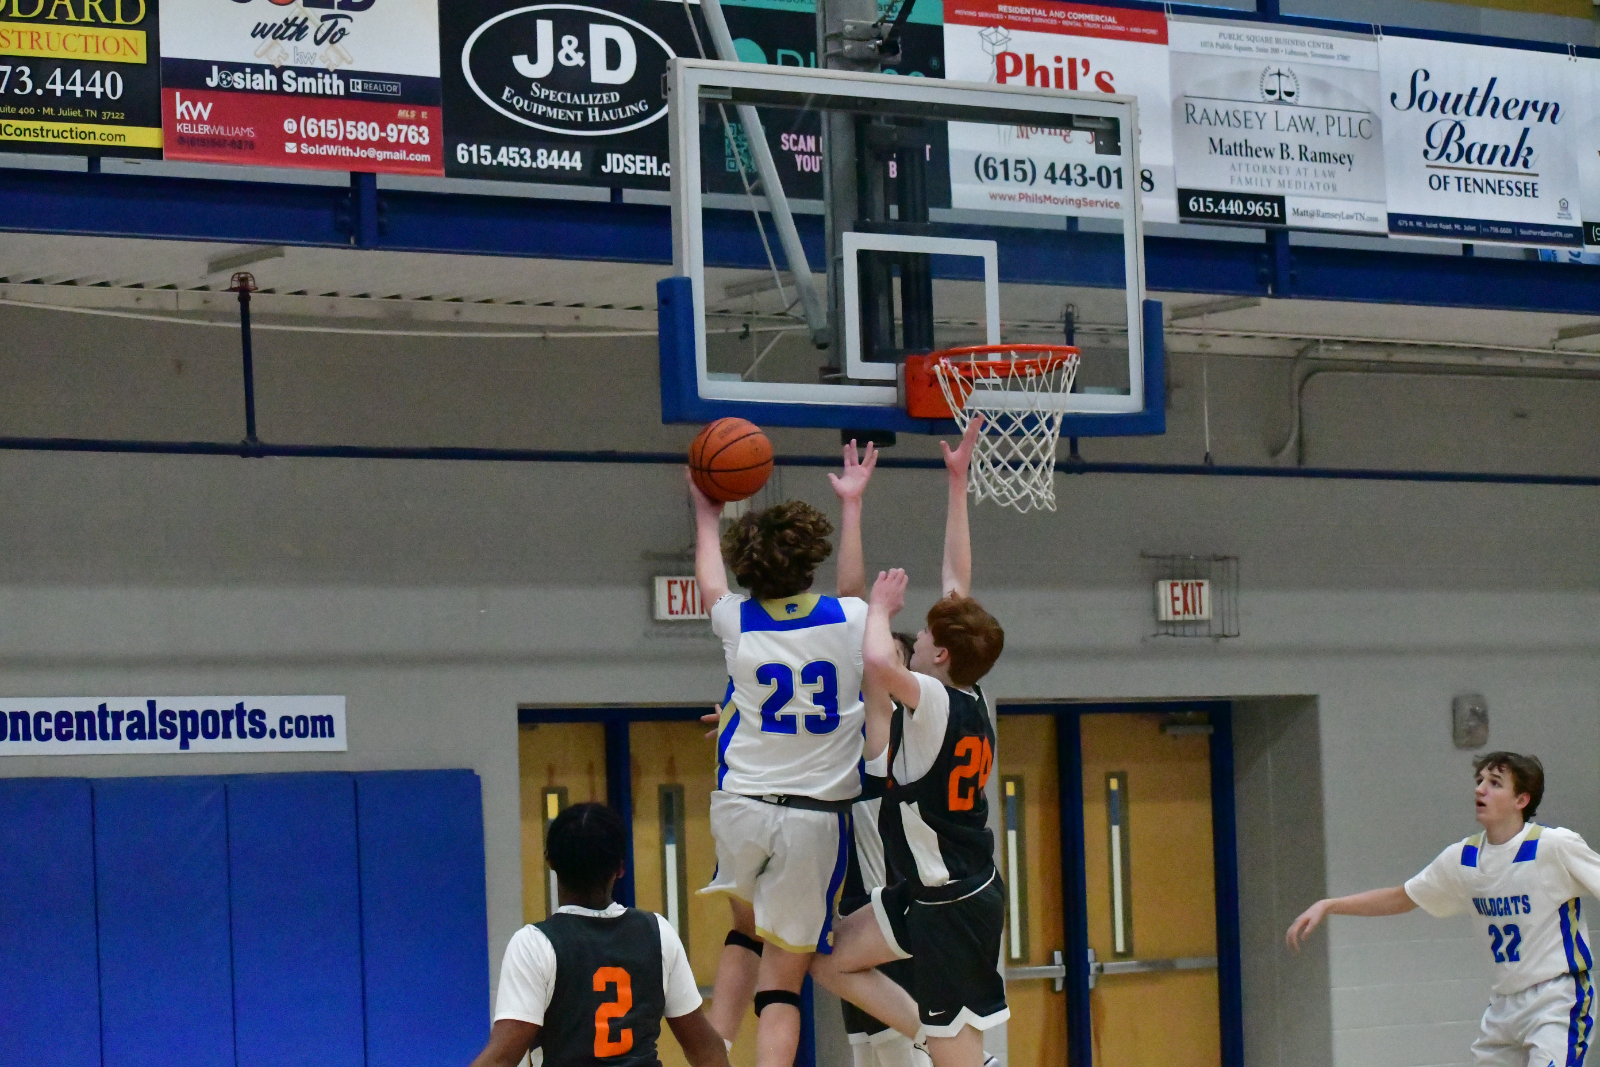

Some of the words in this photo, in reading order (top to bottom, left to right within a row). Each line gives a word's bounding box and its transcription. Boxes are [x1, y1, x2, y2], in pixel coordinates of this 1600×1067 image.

[998, 4, 1047, 16] RESIDENTIAL
[1049, 10, 1066, 18] AND
[1068, 11, 1117, 24] COMMERCIAL
[250, 16, 310, 42] with
[313, 14, 354, 46] Jo
[1218, 32, 1244, 42] PUBLIC
[1246, 34, 1273, 44] SQUARE
[1274, 37, 1306, 48] BUSINESS
[1308, 40, 1334, 50] CENTER
[0, 65, 123, 100] 73.4440
[282, 70, 345, 96] Smith
[363, 82, 398, 92] REALTOR
[1390, 68, 1566, 124] Southern
[18, 107, 34, 115] 400
[85, 109, 97, 118] TN
[102, 111, 125, 120] 37122
[176, 92, 213, 121] kw
[1326, 114, 1372, 140] PLLC
[300, 143, 430, 162] SoldWithJo@gmail.com
[781, 133, 816, 152] SCAN
[1208, 136, 1276, 160] Matthew
[1298, 144, 1354, 172] Ramsey
[1422, 118, 1540, 169] Bank
[456, 143, 582, 171] 615.453.8444
[1230, 162, 1290, 176] ATTORNEY
[1296, 168, 1309, 177] AT
[1314, 168, 1337, 179] LAW
[974, 154, 1036, 186] (615)
[1044, 162, 1154, 192] 443-018
[1230, 175, 1272, 188] FAMILY
[1277, 179, 1338, 193] MEDIATOR
[1428, 174, 1451, 192] OF
[1454, 176, 1540, 199] TENNESSEE
[1188, 196, 1280, 218] 615.440.9651
[667, 580, 705, 615] EXI
[1170, 582, 1204, 616] EXIT
[755, 658, 842, 736] 23
[1472, 894, 1532, 917] WILDCATS
[1488, 924, 1522, 963] 22
[592, 966, 634, 1058] 2
